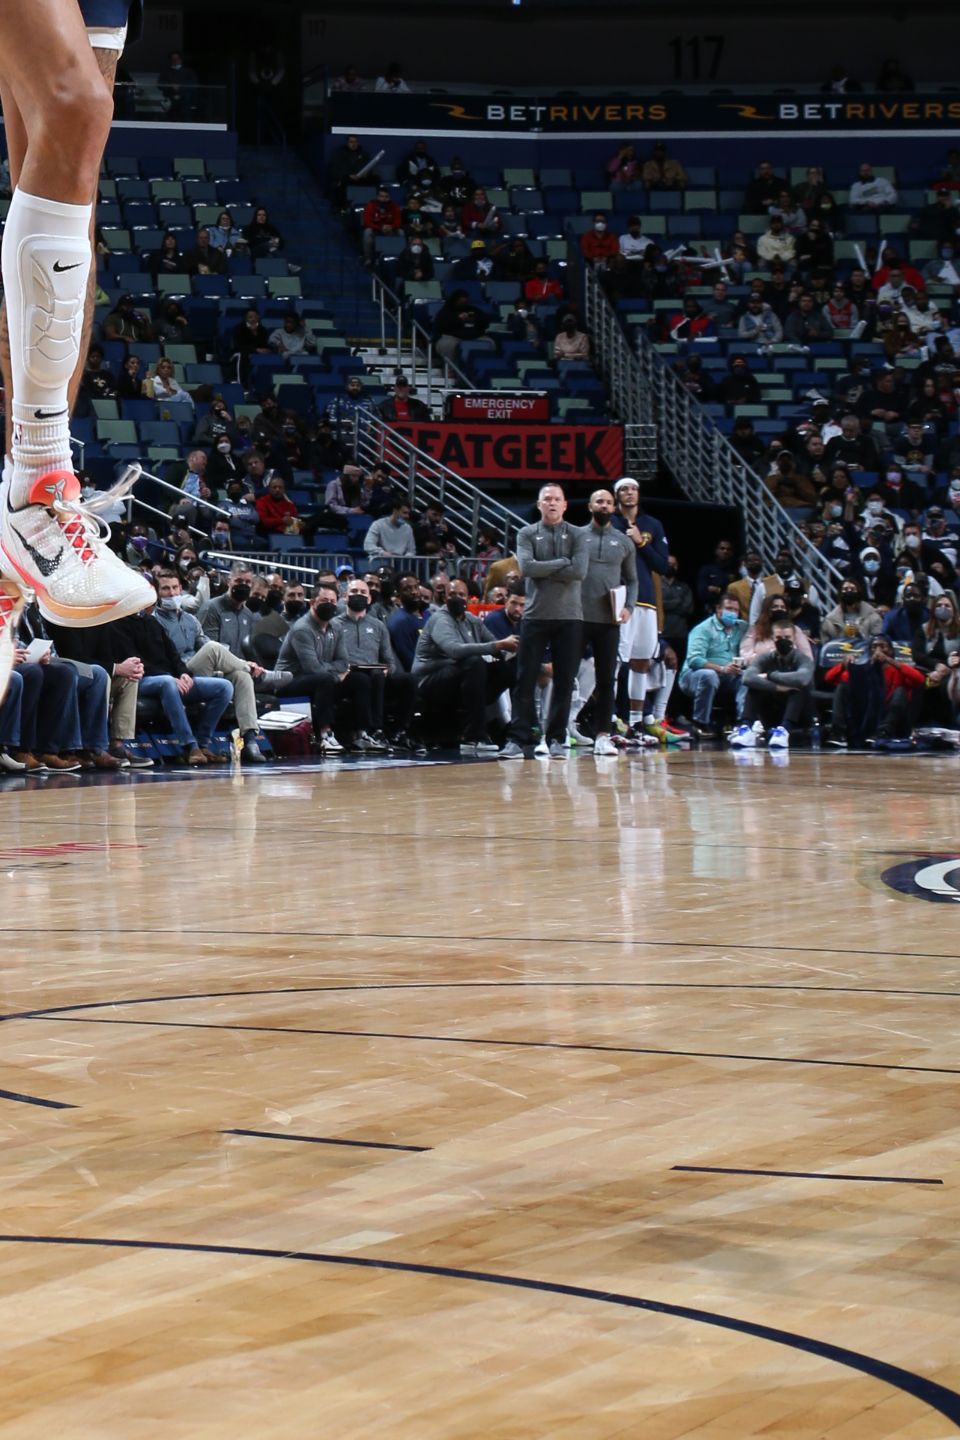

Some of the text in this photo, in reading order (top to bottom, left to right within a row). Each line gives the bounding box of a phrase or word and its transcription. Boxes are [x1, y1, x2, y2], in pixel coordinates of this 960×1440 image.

[668, 35, 726, 80] 117
[487, 104, 667, 121] BETRIVERS
[464, 398, 536, 410] EMERGENCY
[487, 410, 513, 420] EXIT
[394, 427, 608, 476] EATGEEK
